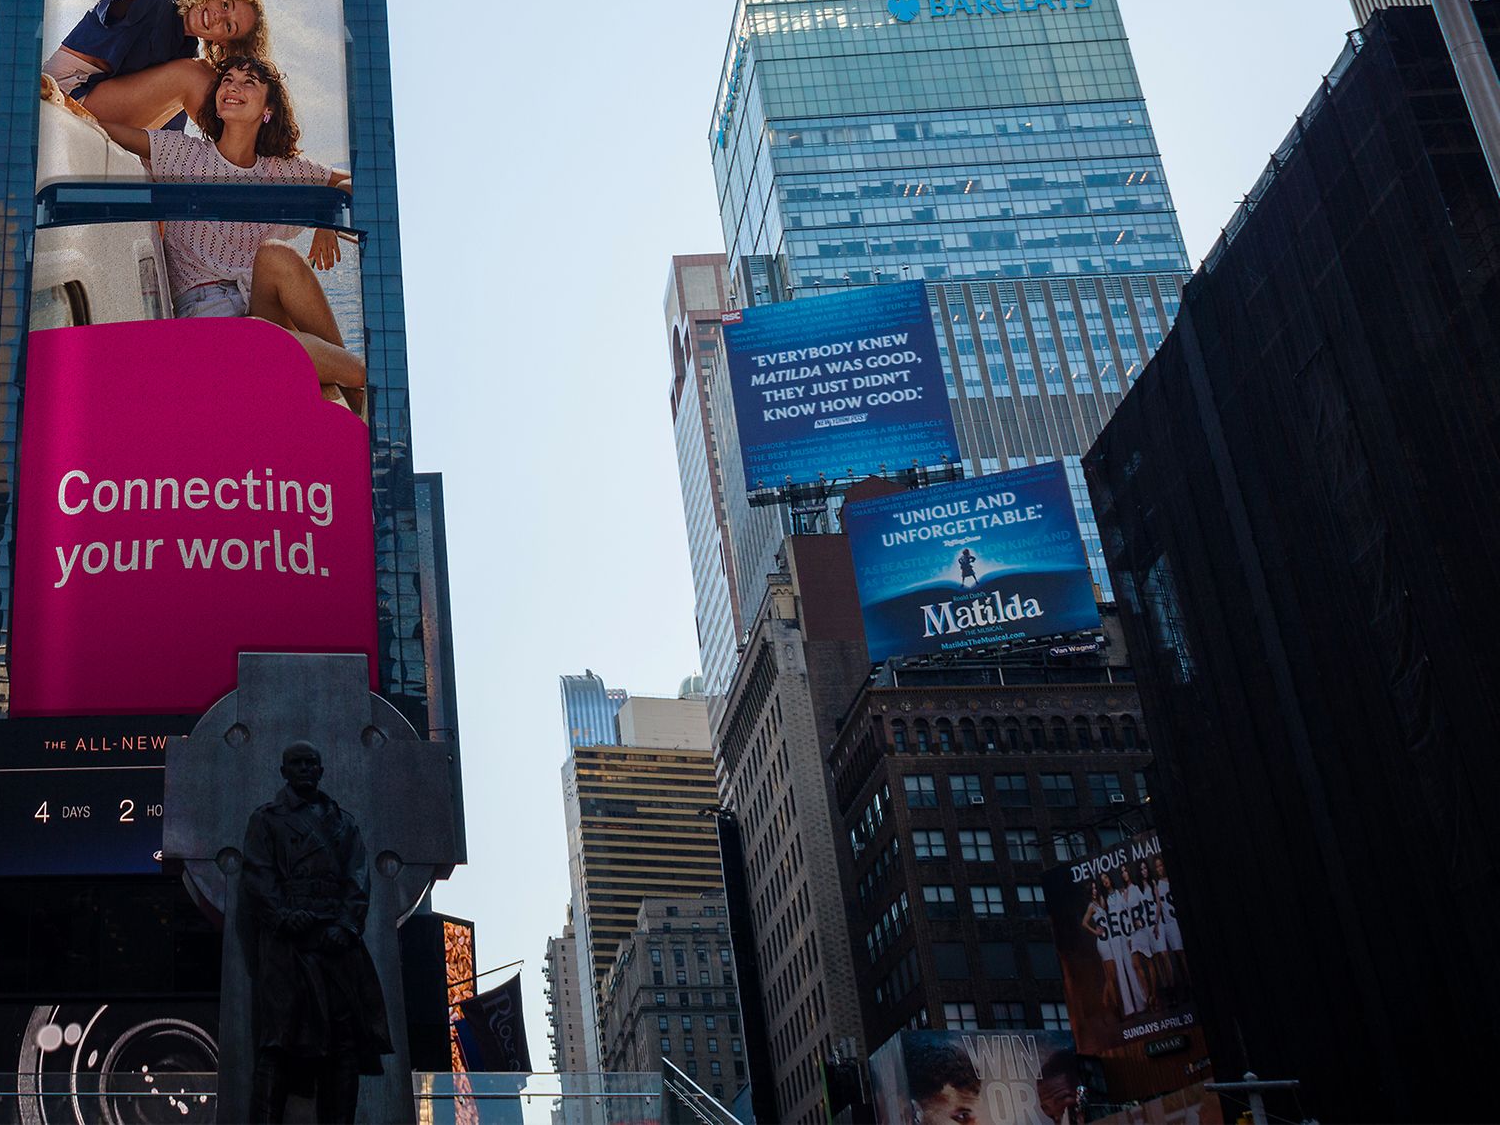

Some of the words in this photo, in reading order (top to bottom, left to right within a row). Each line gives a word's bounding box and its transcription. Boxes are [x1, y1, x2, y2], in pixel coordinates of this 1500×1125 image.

[751, 341, 854, 367] "EVERYBODY
[858, 332, 909, 352] KNEW
[750, 364, 822, 386] MATILDA
[825, 358, 863, 374] WAS
[866, 350, 922, 369] GOOD,
[762, 384, 805, 403] THEY
[808, 379, 849, 396] JUST
[852, 369, 911, 390] DIDN'T
[762, 402, 817, 422] KNOW
[819, 395, 863, 414] HOW
[57, 468, 334, 527] Connecting
[892, 500, 971, 526] "UNIQUE
[975, 491, 1017, 511] AND
[881, 503, 1044, 547] UNFORGETTABLE."
[1042, 529, 1071, 544] AND
[54, 535, 164, 589] your
[177, 529, 330, 578] world.
[920, 590, 1044, 638] Matilda
[977, 624, 1003, 634] MUSICAL
[940, 630, 1026, 651] MatildaTheMusical.com
[1053, 646, 1067, 654] Van
[1067, 643, 1097, 654] Wagner
[44, 740, 67, 750] THE
[75, 735, 167, 751] ALL-NEW
[34, 800, 50, 823] 4
[62, 805, 91, 818] DAYS
[119, 799, 135, 822] 2
[1070, 848, 1128, 884] DEVIOUS
[1096, 892, 1181, 941] SECRETS
[1123, 1021, 1159, 1040] SUNDAYS
[1158, 1015, 1184, 1030] APRIL
[1183, 1012, 1194, 1025] 20
[962, 1034, 1043, 1080] WIN
[986, 1082, 1043, 1125] OR
